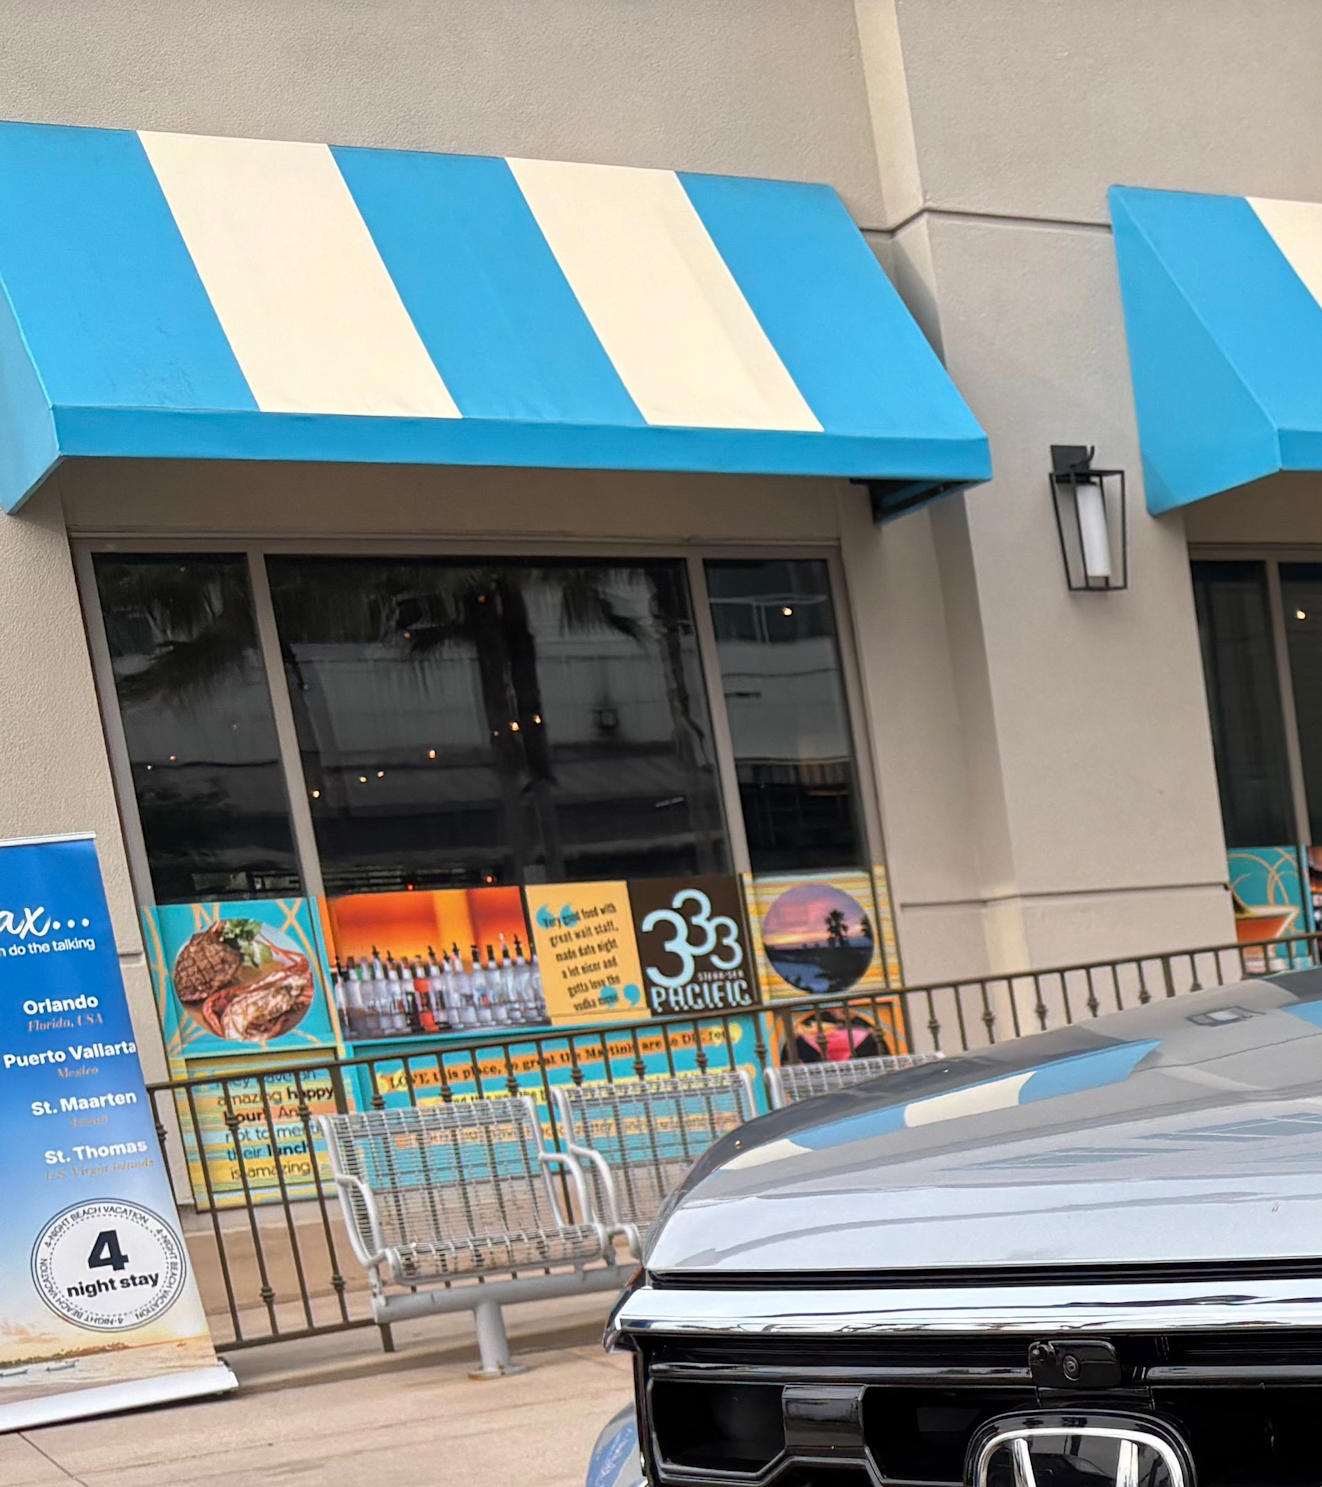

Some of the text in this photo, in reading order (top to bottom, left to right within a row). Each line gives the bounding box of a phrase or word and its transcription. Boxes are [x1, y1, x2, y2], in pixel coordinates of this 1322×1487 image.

[580, 906, 599, 920] food
[600, 902, 617, 915] with
[9, 945, 26, 957] do
[28, 941, 51, 955] the
[52, 937, 96, 951] talking
[549, 932, 573, 948] great
[574, 927, 593, 941] wait
[642, 888, 743, 988] 333
[555, 938, 619, 963] made date night
[562, 969, 568, 980] a
[569, 964, 581, 978] lot
[603, 956, 618, 970] and
[23, 994, 99, 1015] Orlando
[650, 978, 752, 1013] PACIFIC
[3, 1040, 137, 1069] Puerto Vallarta
[31, 1092, 137, 1117] St. Maarten
[44, 1140, 149, 1165] St. Thomas
[70, 1207, 102, 1222] BEACH
[103, 1206, 150, 1225] VACATION
[88, 1229, 130, 1272] 4
[67, 1272, 160, 1298] night stay
